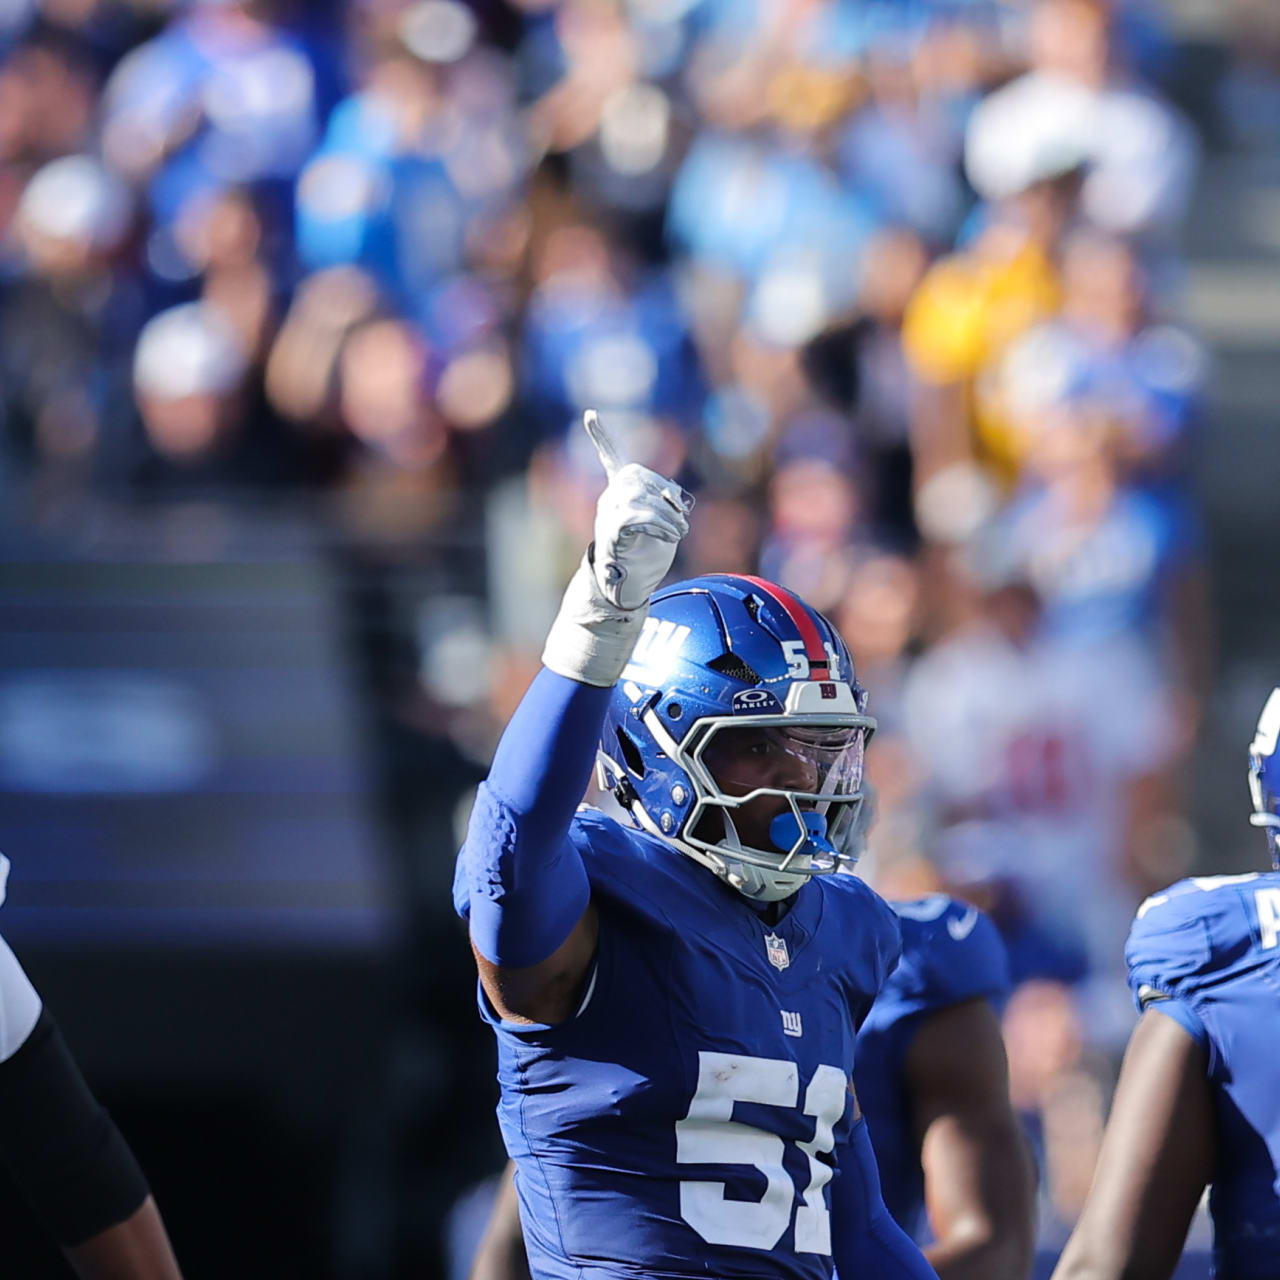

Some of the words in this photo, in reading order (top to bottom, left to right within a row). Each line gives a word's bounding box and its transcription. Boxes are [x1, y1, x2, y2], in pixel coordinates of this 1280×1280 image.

[782, 640, 841, 680] 51
[734, 700, 775, 709] OAKLEY
[676, 1051, 849, 1256] 51
